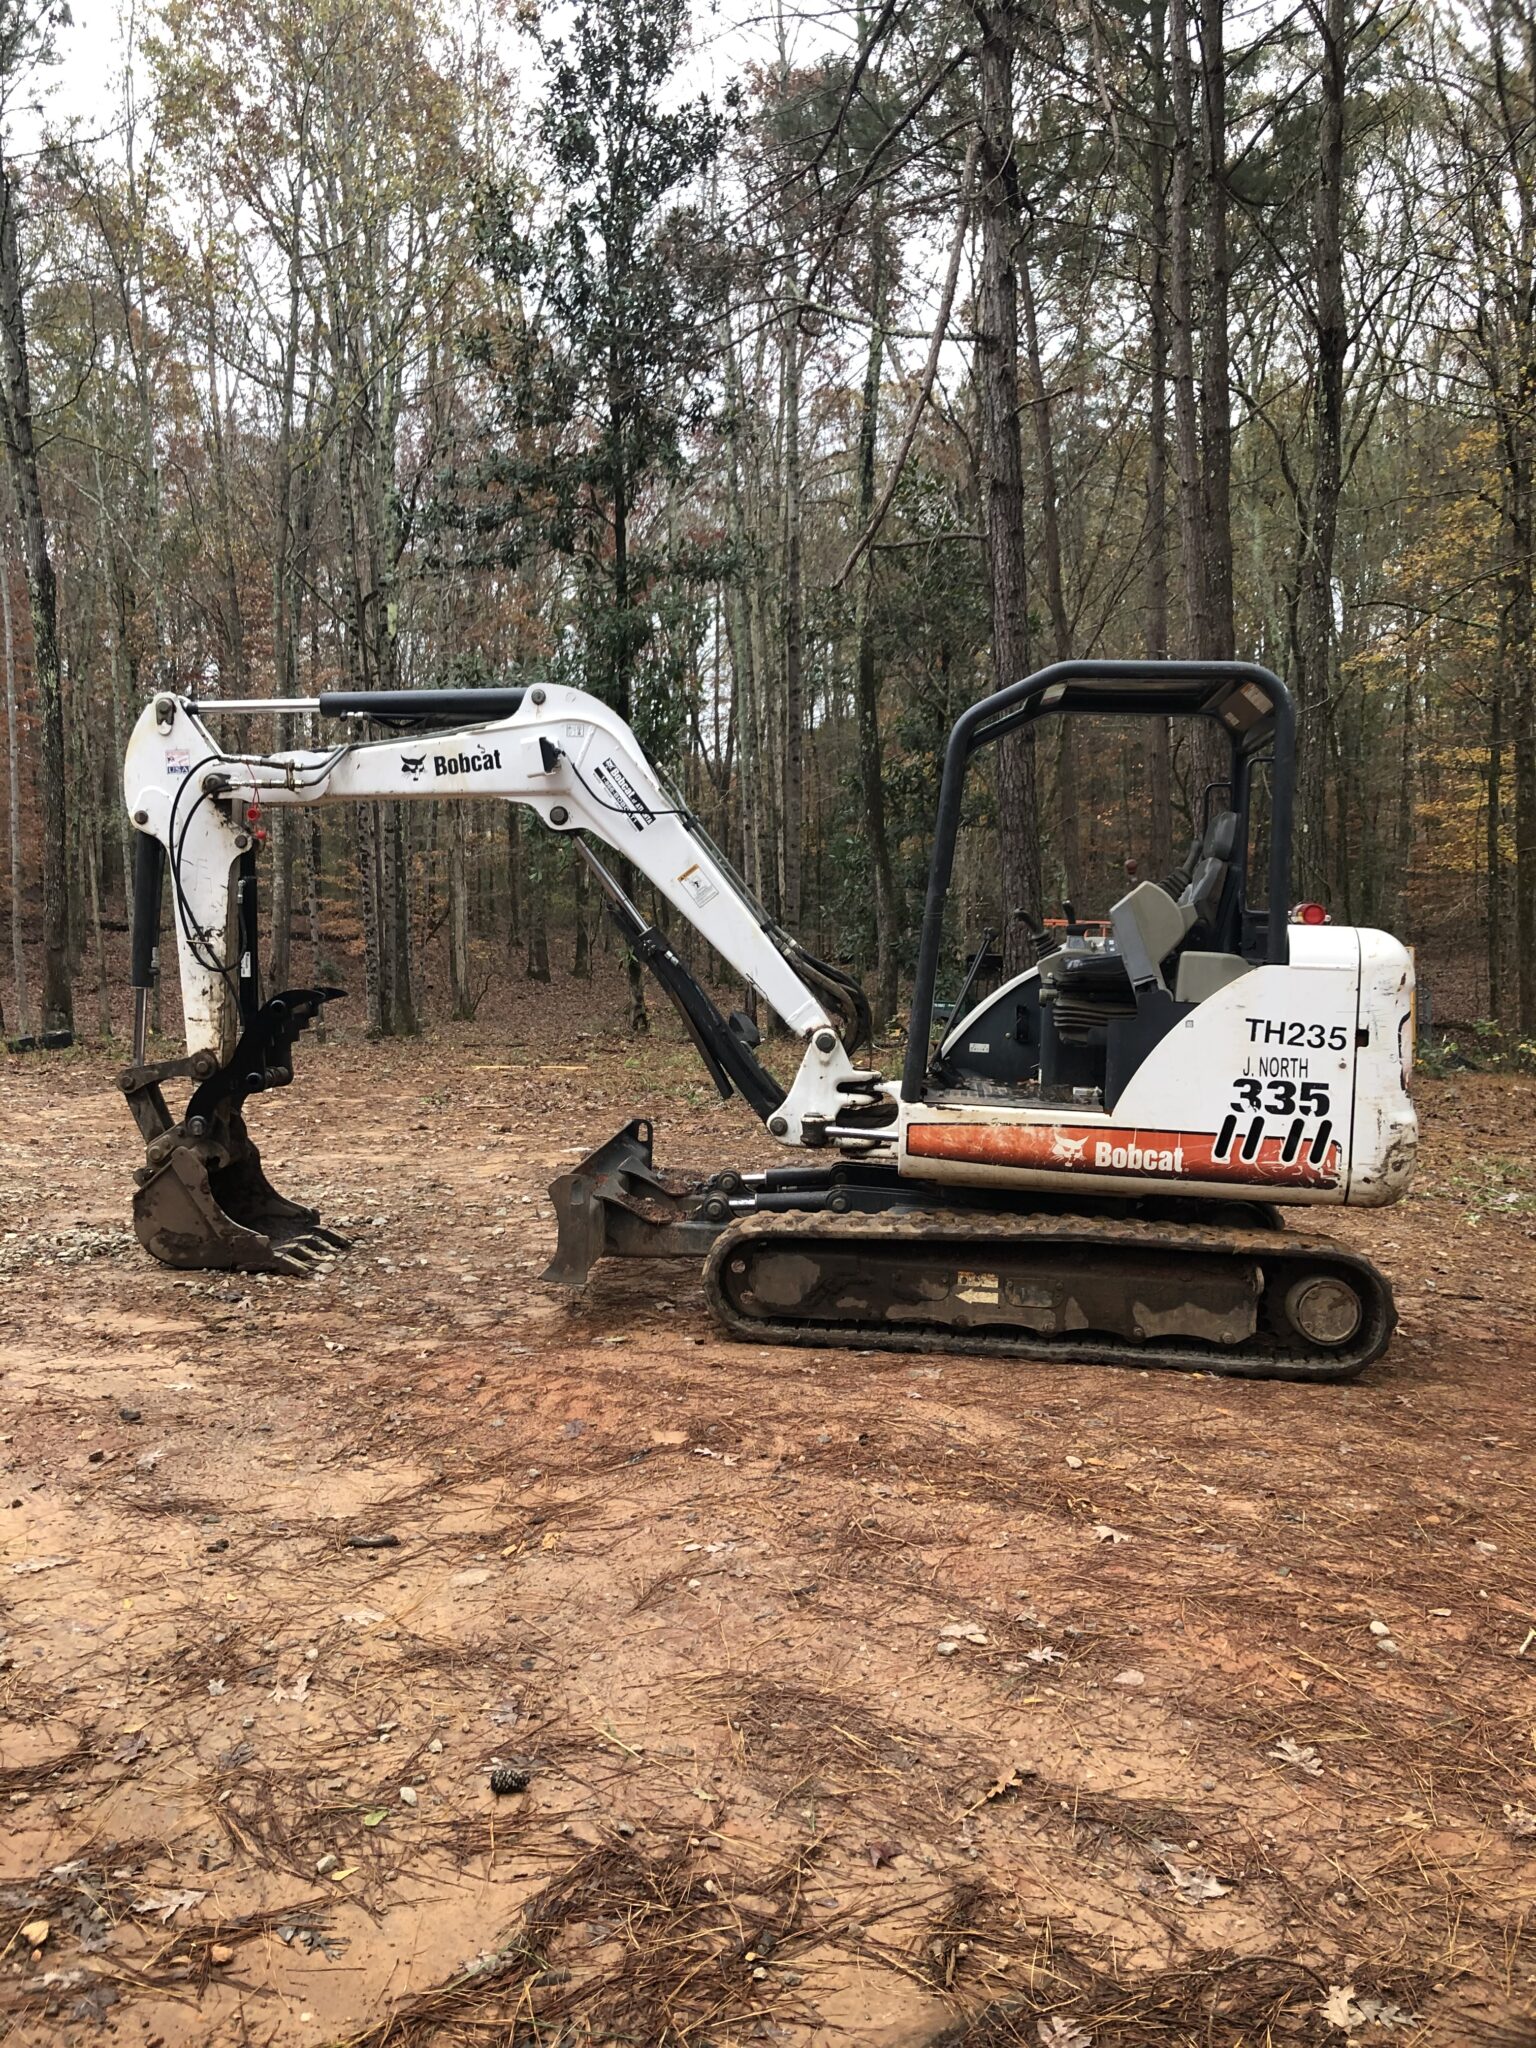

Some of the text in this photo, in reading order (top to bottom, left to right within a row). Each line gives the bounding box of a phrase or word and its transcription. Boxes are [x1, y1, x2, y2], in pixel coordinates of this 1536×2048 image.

[434, 749, 502, 776] Bobcat
[610, 767, 636, 799] Bobcat
[635, 803, 653, 824] ATLNTA
[1245, 1018, 1348, 1051] TH235
[1242, 1056, 1309, 1078] J. NORTH
[1230, 1078, 1331, 1117] 335
[1095, 1142, 1185, 1173] Bobcat
